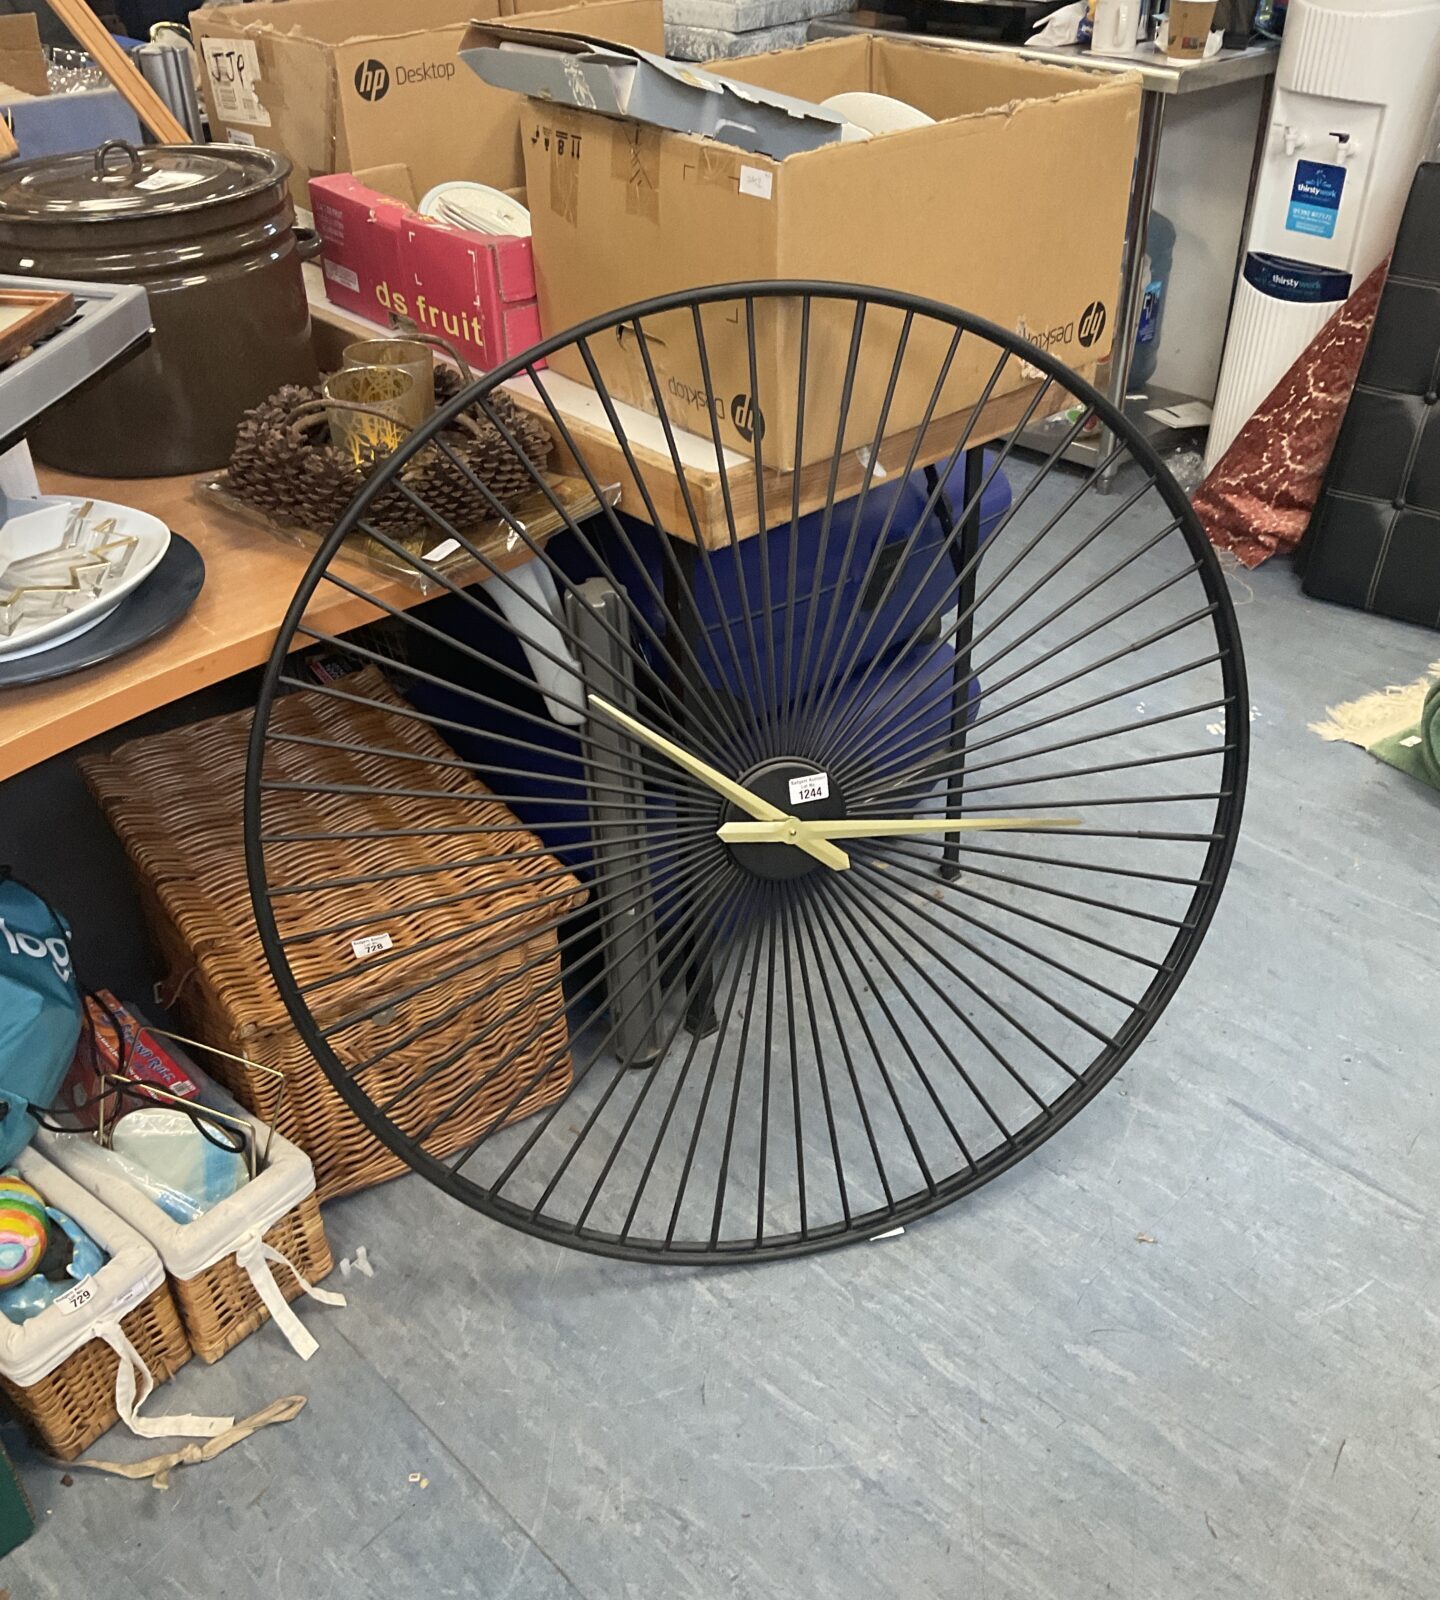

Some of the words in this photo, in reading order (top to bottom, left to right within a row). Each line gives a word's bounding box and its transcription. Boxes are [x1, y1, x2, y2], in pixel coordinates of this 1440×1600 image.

[359, 60, 386, 101] hp
[395, 62, 455, 86] Desktop
[416, 295, 484, 347] fruit
[1079, 301, 1105, 346] hp
[667, 376, 726, 420] Dsktop
[798, 786, 822, 800] 1244
[366, 943, 383, 953] 728
[70, 1290, 91, 1308] 729
